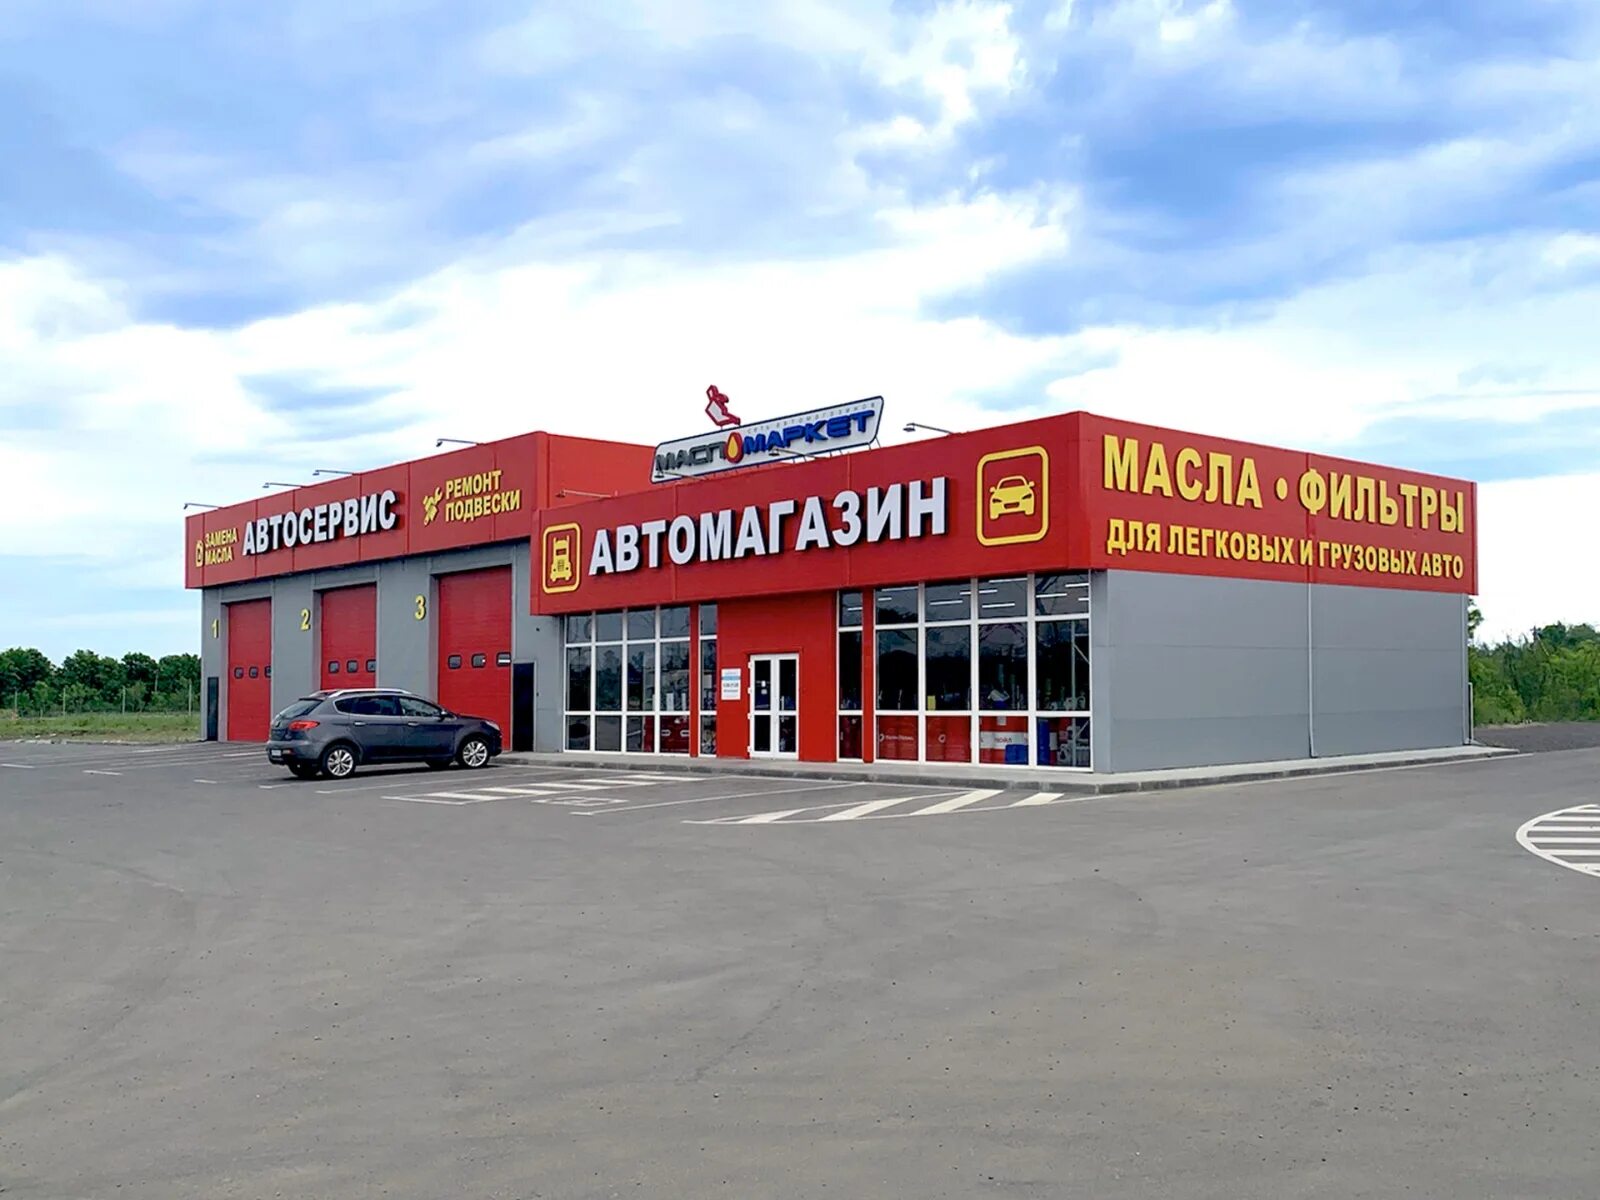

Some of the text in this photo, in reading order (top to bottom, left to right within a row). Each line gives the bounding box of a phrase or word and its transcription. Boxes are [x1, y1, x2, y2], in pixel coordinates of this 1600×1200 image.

[445, 470, 502, 500] РЕМОНТ
[1103, 434, 1465, 533] МАСЛА ФИЛЬТРЫ
[445, 489, 521, 523] ПОДВЕСКИ
[241, 489, 397, 556] АВТОСЕРВИС
[588, 476, 947, 576] АВТОМАГАЗИН
[204, 528, 239, 548] ЗАМЕНА
[1107, 518, 1464, 579] ДЛЯ ЛЕГКОВЫХ И ГРУЗОВЫХ АВТО
[204, 546, 234, 566] МАСЛА
[301, 608, 311, 631] 2
[415, 595, 426, 620] 3
[211, 619, 219, 638] 1
